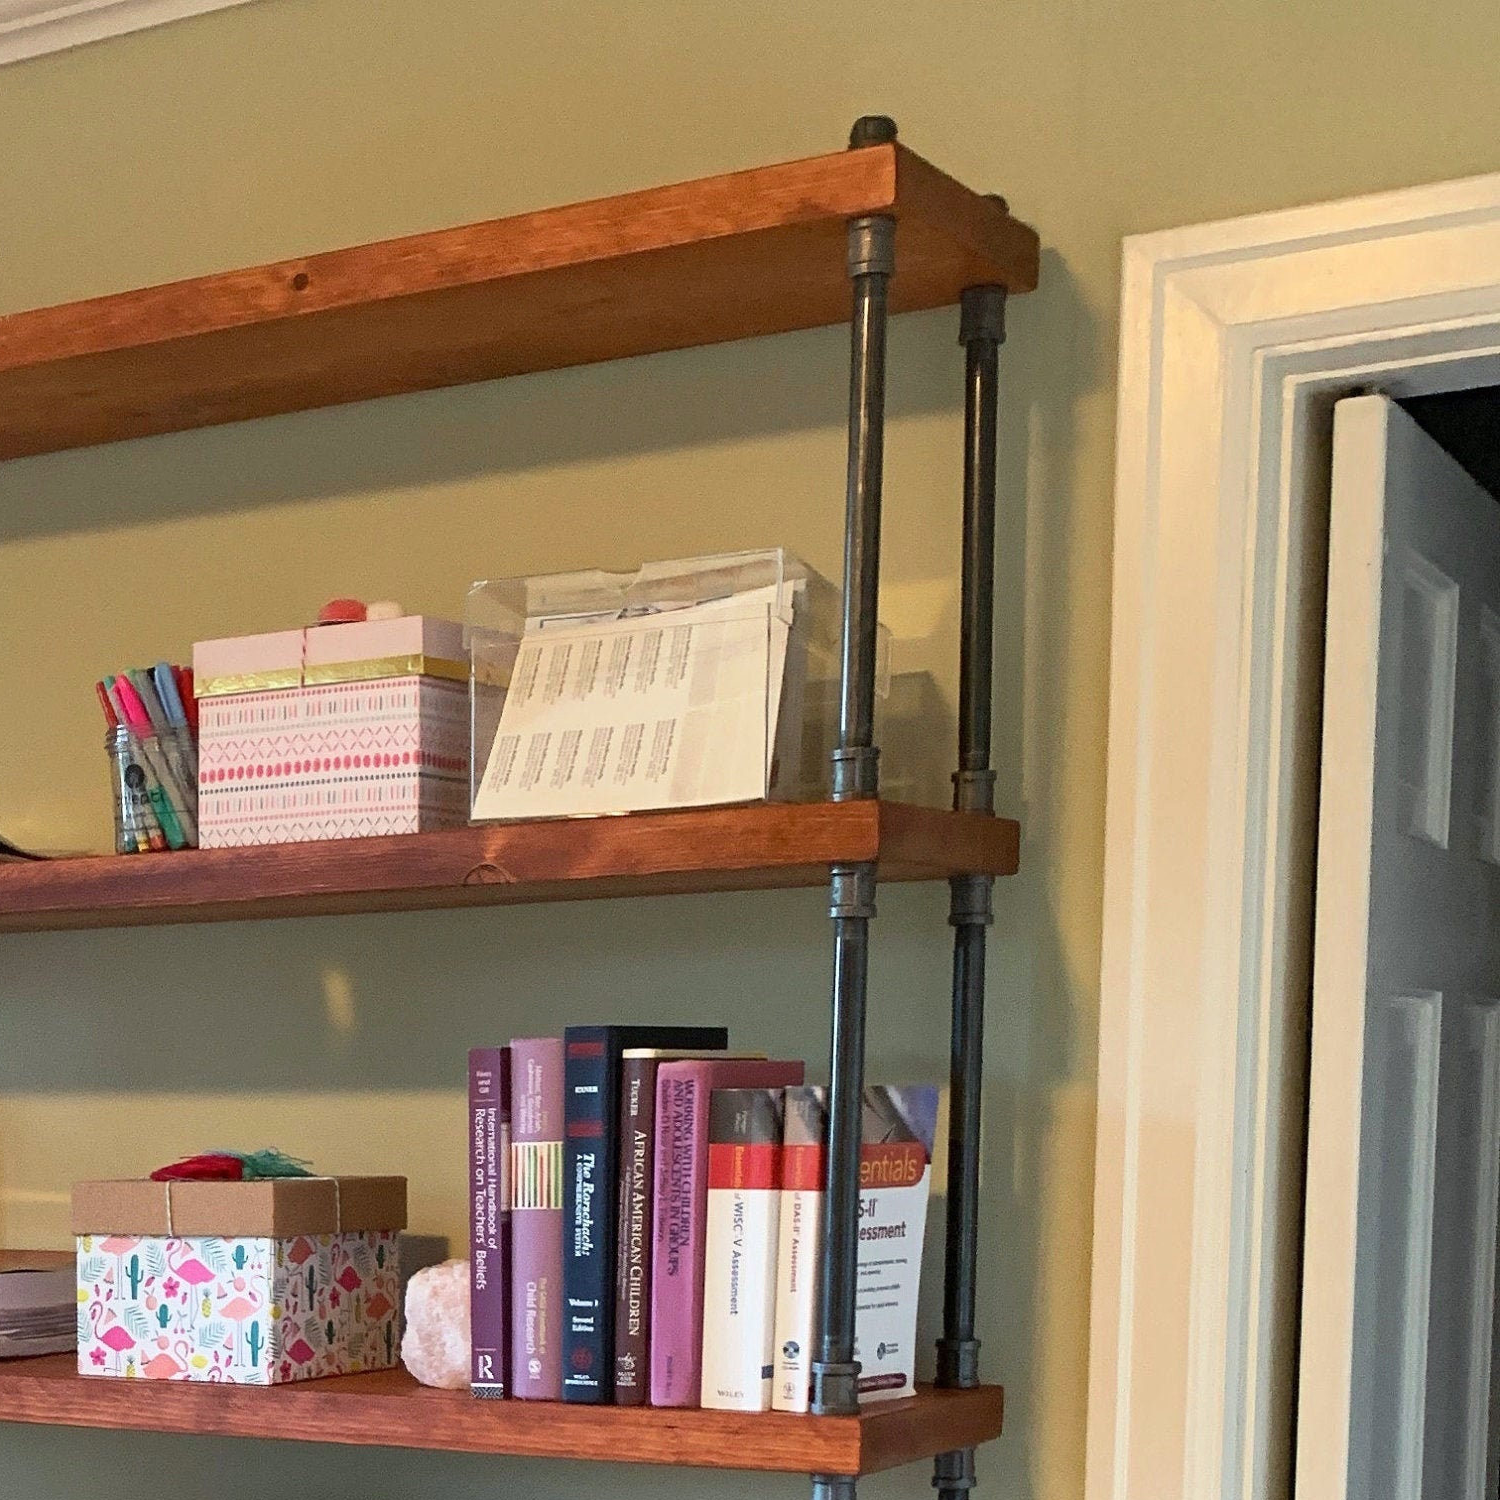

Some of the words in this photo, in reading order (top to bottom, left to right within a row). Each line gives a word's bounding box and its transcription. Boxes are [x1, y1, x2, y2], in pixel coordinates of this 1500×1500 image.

[630, 1079, 641, 1116] TUCKER
[673, 1079, 684, 1107] AND
[683, 1079, 695, 1141] WORKING
[475, 1108, 486, 1164] Research
[487, 1107, 497, 1175] International
[475, 1168, 486, 1185] on
[582, 1153, 595, 1179] The
[632, 1130, 647, 1190] AFRICAN
[670, 1110, 684, 1203] ADOLESCENTS
[682, 1143, 693, 1178] WITH
[859, 1149, 918, 1183] entials
[487, 1178, 497, 1234] Handbook
[670, 1205, 680, 1220] IN
[679, 1180, 692, 1246] CHILDREN
[487, 1238, 497, 1249] of
[630, 1192, 646, 1263] AMERICAN
[859, 1221, 907, 1240] essment
[667, 1222, 680, 1276] GROUPS
[790, 1238, 800, 1293] Assessment
[475, 1250, 487, 1290] Beliefs
[730, 1249, 742, 1315] Assessment
[526, 1281, 537, 1308] Child
[629, 1266, 644, 1336] CHILDREN
[526, 1310, 537, 1354] Research
[572, 1316, 594, 1324] Second
[572, 1324, 594, 1332] Edition
[717, 1389, 744, 1398] WILEY
